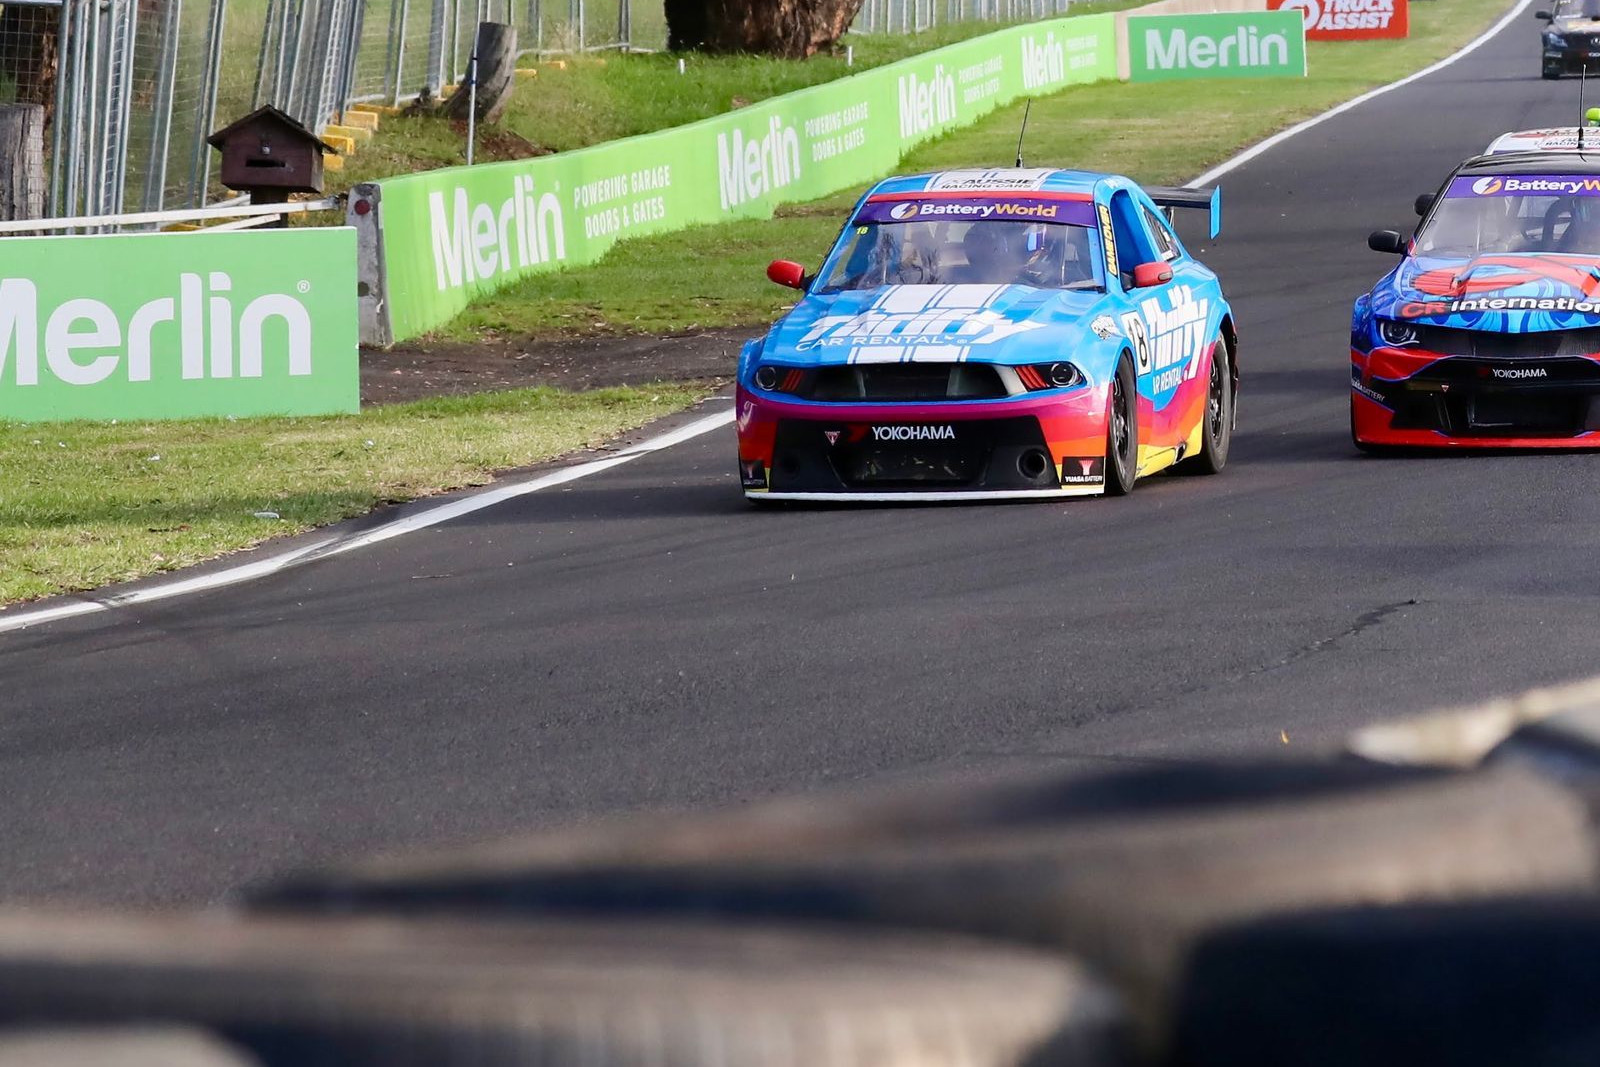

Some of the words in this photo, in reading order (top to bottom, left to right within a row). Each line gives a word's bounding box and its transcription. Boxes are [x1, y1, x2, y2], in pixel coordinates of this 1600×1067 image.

[1317, 11, 1394, 31] ASSIST
[1021, 30, 1065, 90] Merlin
[1145, 26, 1288, 70] Merlin
[898, 64, 957, 138] Merlin
[805, 113, 842, 139] POWERING
[843, 102, 868, 127] GARAGE
[718, 115, 801, 211] Merlin
[811, 136, 836, 163] DOORS
[845, 127, 865, 151] GATES
[574, 173, 627, 209] POWERING
[631, 165, 671, 191] GARAGE
[585, 209, 620, 239] DOORS
[622, 205, 630, 227] &
[632, 196, 665, 224] GATES
[919, 203, 1057, 218] BatteryWorld
[429, 174, 566, 292] Merlin
[1402, 301, 1447, 318] CR
[795, 336, 843, 352] CAR
[857, 334, 945, 345] RENTAL
[1493, 368, 1547, 378] YOKOHAMA
[872, 425, 955, 440] YOKOHAMA
